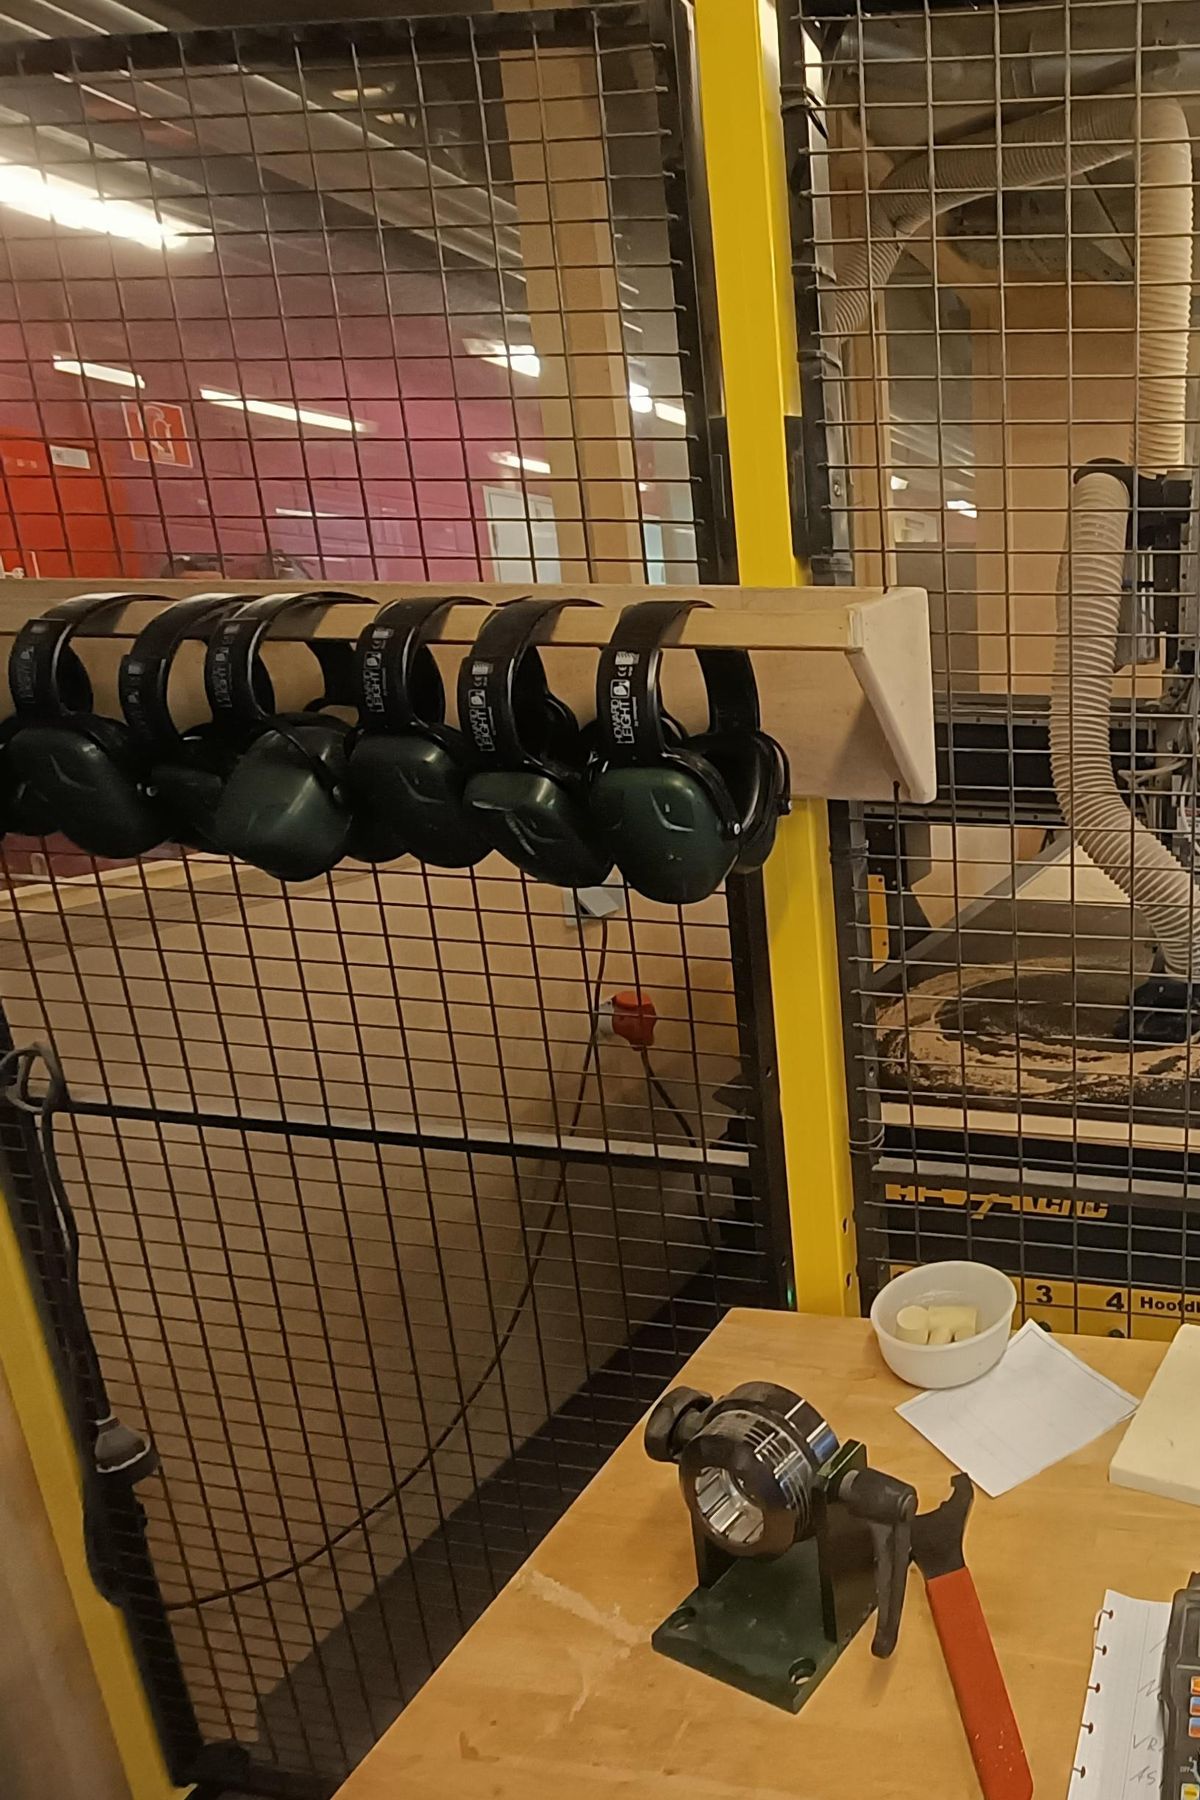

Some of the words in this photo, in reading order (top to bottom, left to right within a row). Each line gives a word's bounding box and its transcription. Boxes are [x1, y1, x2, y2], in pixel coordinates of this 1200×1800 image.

[619, 700, 635, 744] LEIGHT
[1035, 1285, 1054, 1305] 3
[1106, 1292, 1125, 1311] 4
